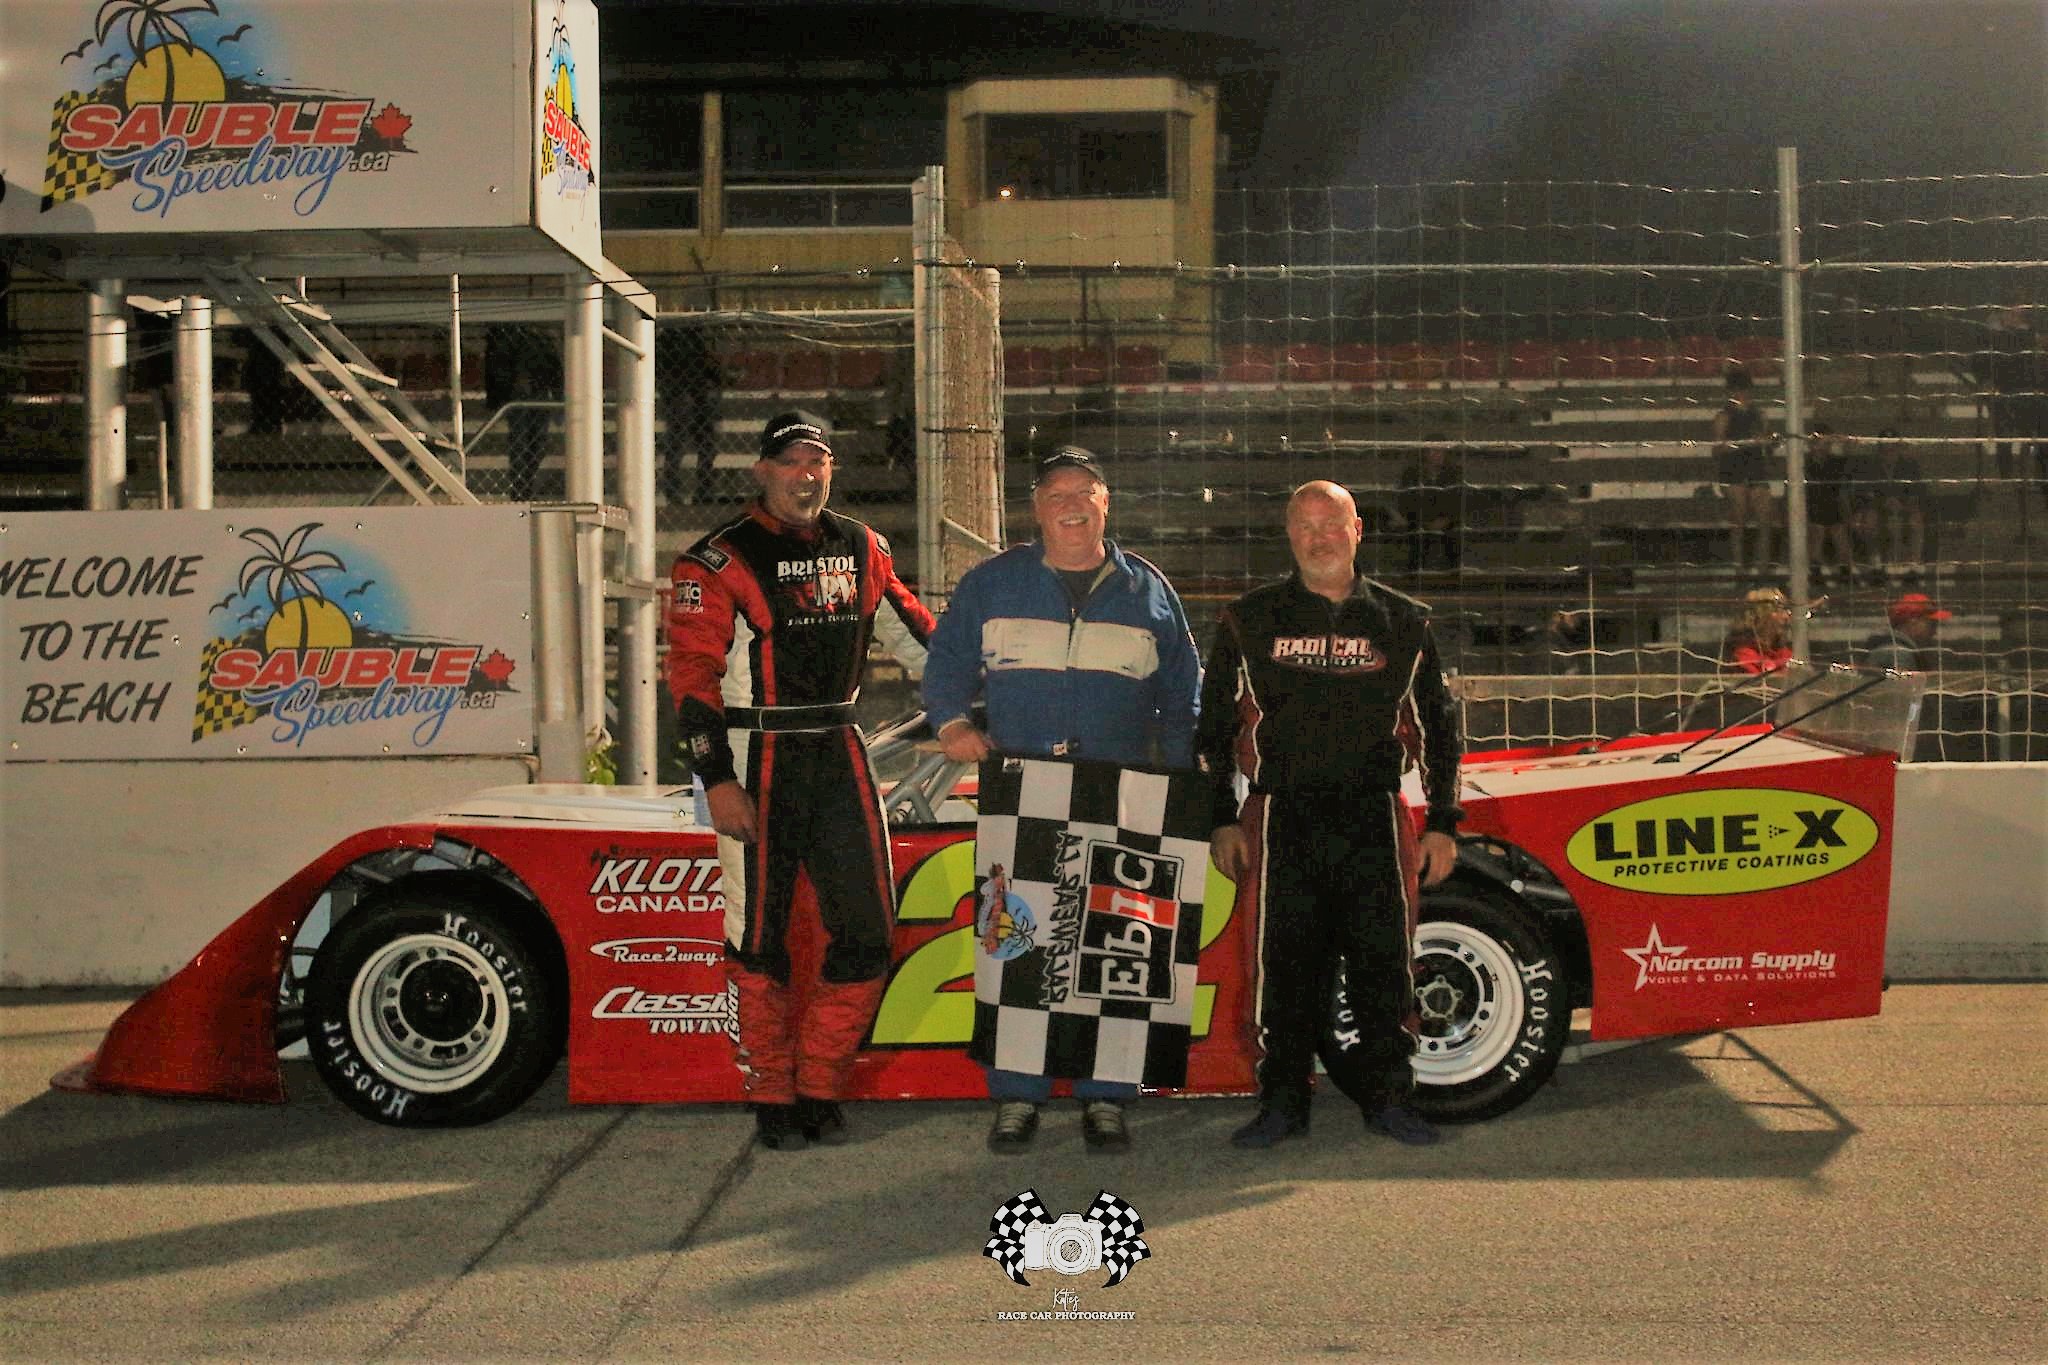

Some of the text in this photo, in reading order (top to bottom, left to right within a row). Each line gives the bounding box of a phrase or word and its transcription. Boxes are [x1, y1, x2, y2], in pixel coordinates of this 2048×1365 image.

[62, 98, 374, 151] SAUBLE
[545, 99, 591, 171] SAUBLE
[100, 137, 353, 217] Speedway
[777, 555, 858, 577] BRISTOL
[19, 618, 169, 662] TO THE
[1273, 636, 1371, 656] RADICAL
[207, 645, 484, 691] SAUBLE
[21, 681, 171, 724] BEACH
[241, 678, 464, 747] Speedway
[1613, 853, 1830, 878] PROTECTIVE COATINGS
[596, 895, 725, 913] CANADA
[440, 912, 528, 1012] Hoosier
[612, 946, 725, 967] Race2way.
[1648, 971, 1837, 985] VOICE & DATA SOLUTIONS
[1649, 950, 1837, 973] Norcom Supply
[591, 986, 728, 1019] Classi
[1504, 958, 1554, 1083] Hoosier
[323, 1020, 412, 1119] Hoosier
